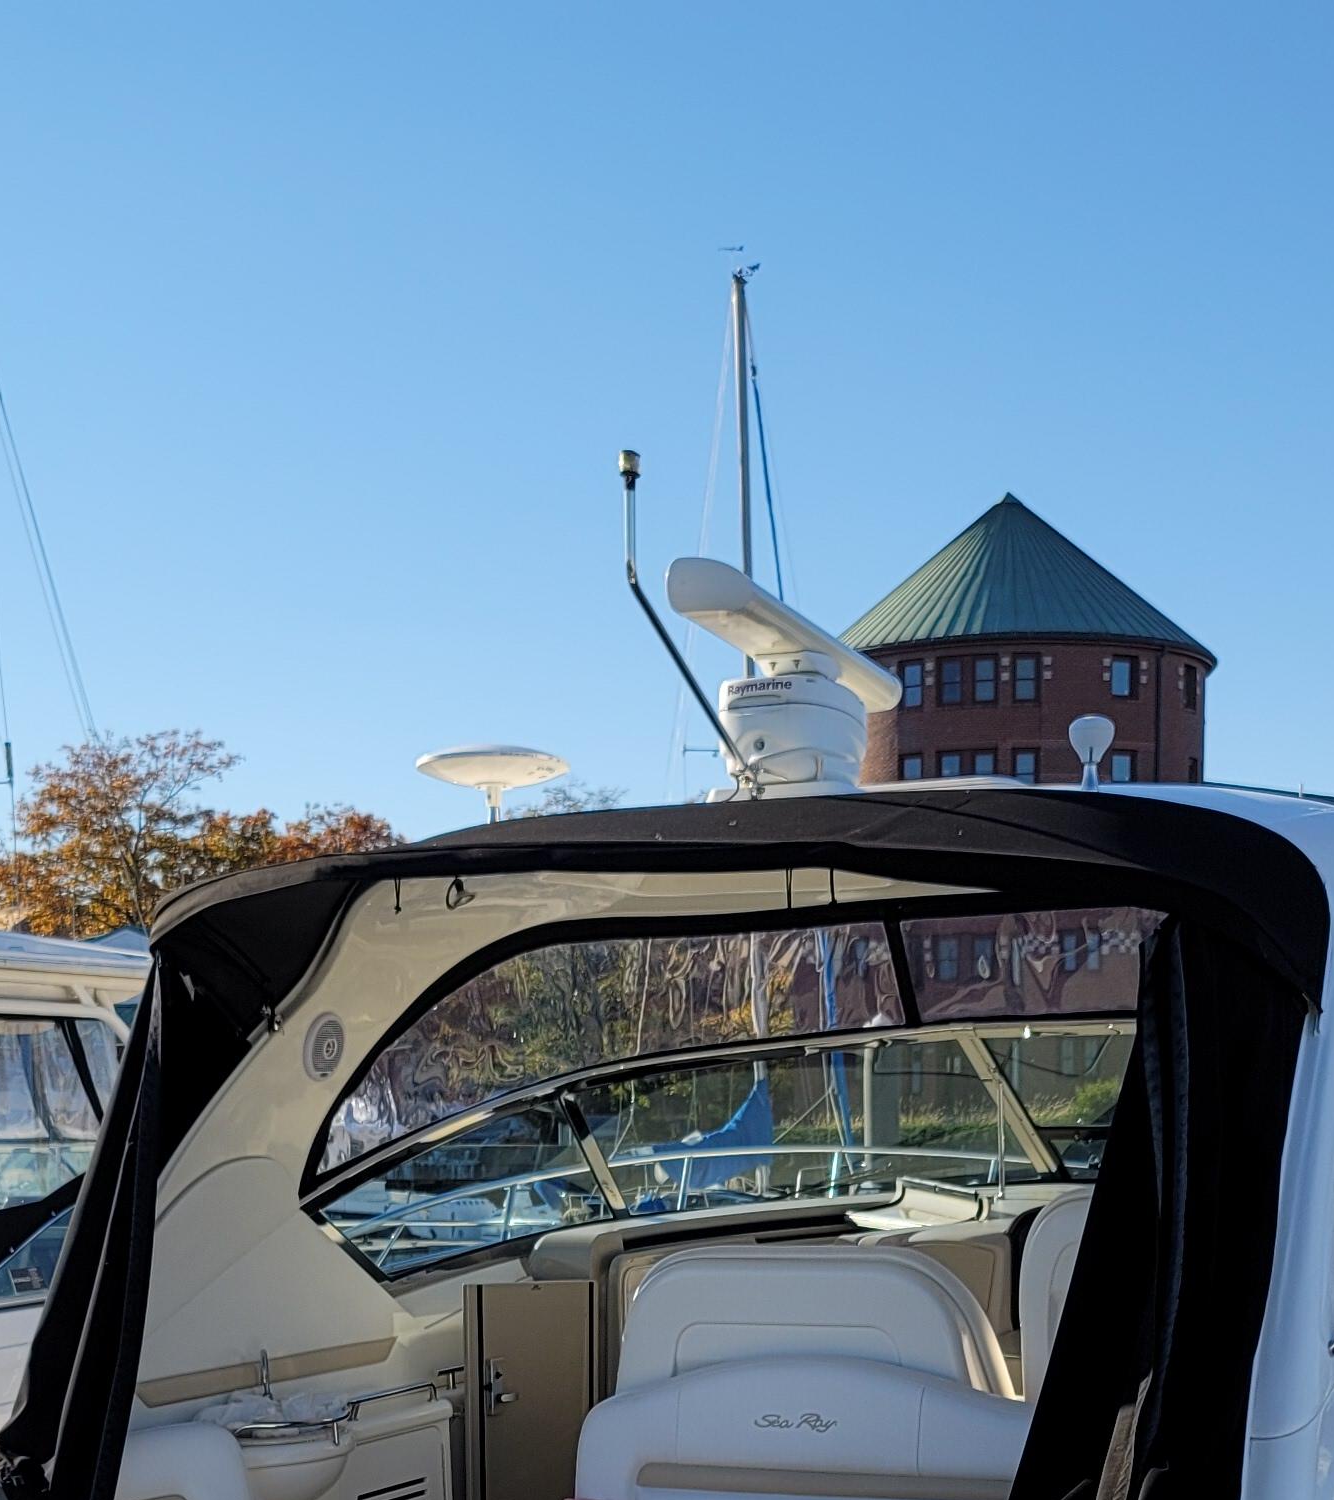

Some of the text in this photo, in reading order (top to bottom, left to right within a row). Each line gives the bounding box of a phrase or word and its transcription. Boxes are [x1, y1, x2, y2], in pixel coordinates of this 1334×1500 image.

[728, 679, 792, 697] Raymarine
[754, 1413, 838, 1433] Sea Ray
